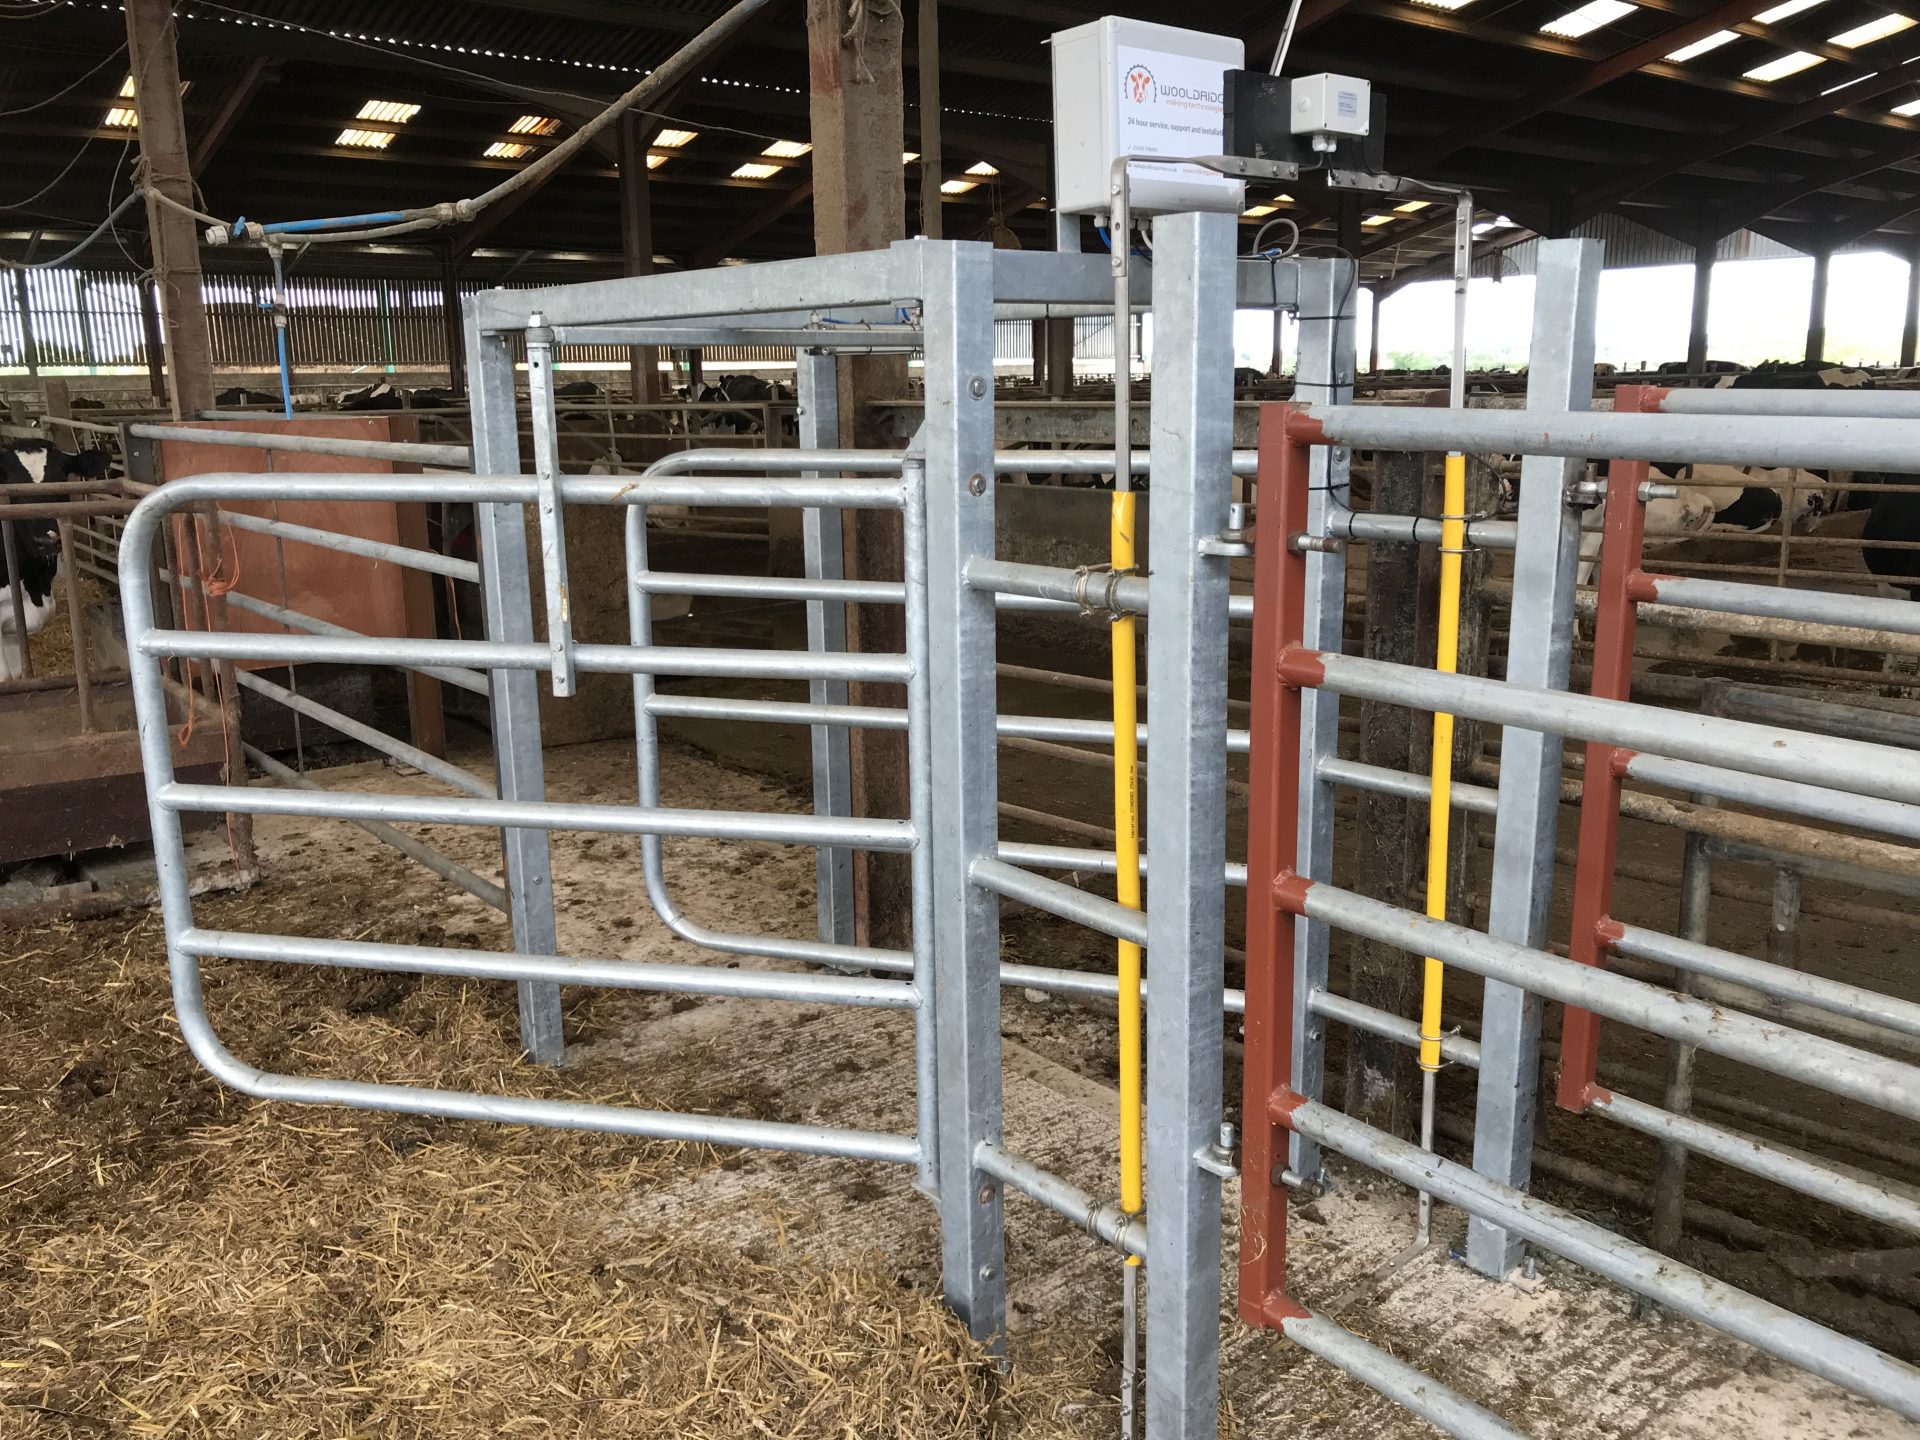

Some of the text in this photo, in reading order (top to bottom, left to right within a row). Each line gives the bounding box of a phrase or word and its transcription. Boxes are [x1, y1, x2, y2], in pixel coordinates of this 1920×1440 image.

[1127, 117, 1135, 126] 24
[1135, 118, 1149, 127] hour
[1170, 124, 1191, 133] support
[1191, 126, 1201, 134] and
